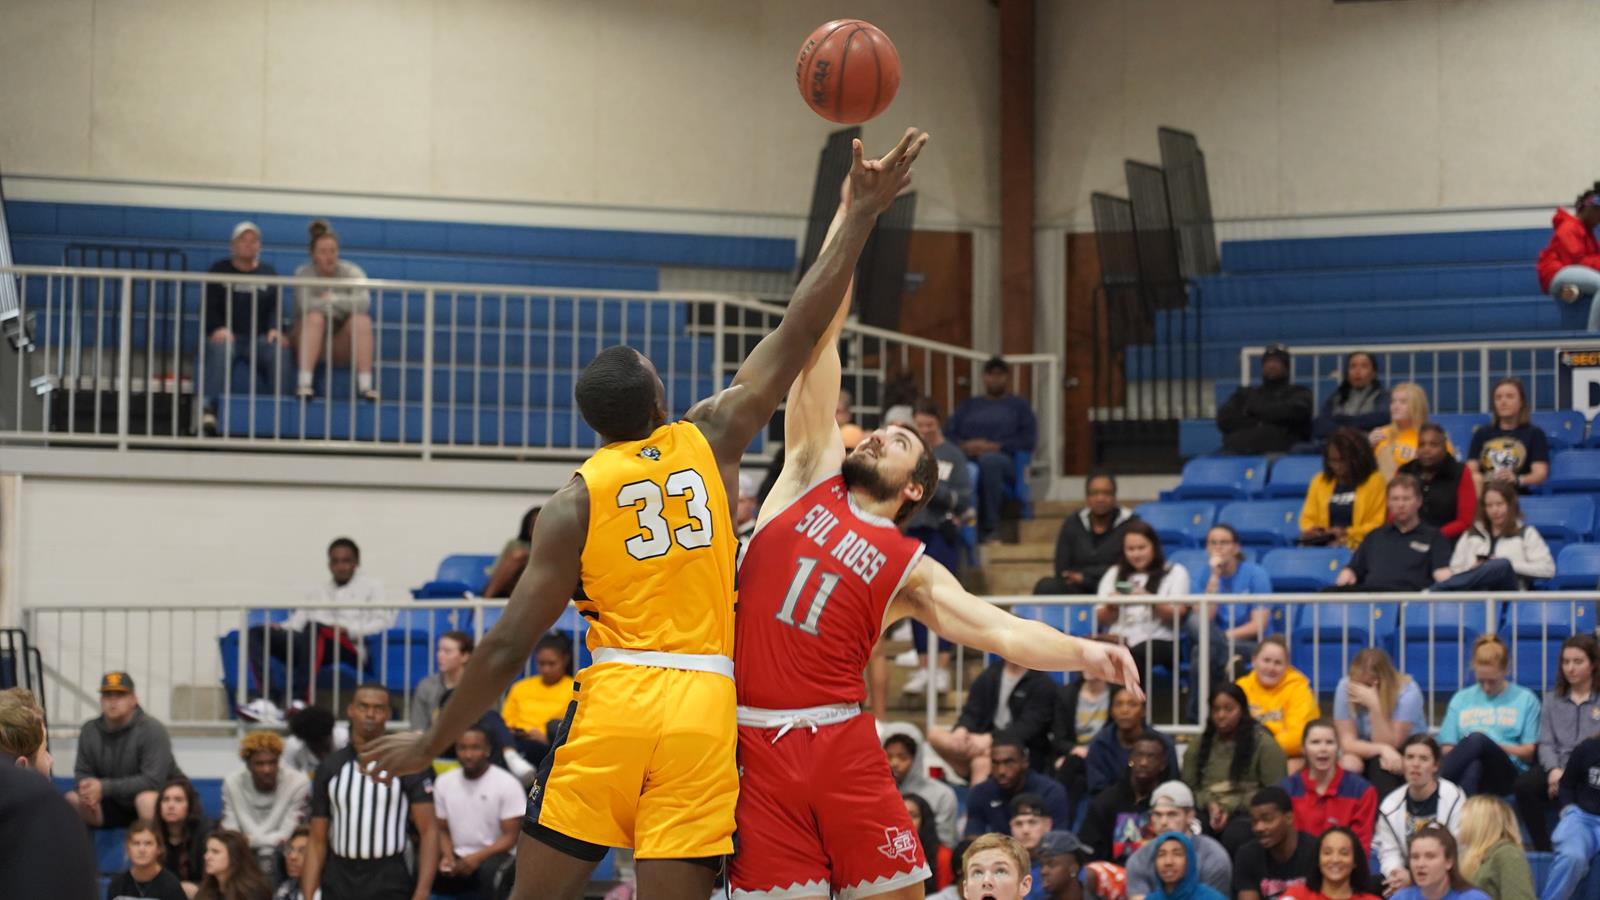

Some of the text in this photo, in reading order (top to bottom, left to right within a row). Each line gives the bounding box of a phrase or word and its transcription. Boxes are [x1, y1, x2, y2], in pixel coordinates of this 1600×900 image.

[616, 468, 713, 561] 33
[794, 503, 887, 585] SUL ROSS
[775, 556, 841, 636] 11
